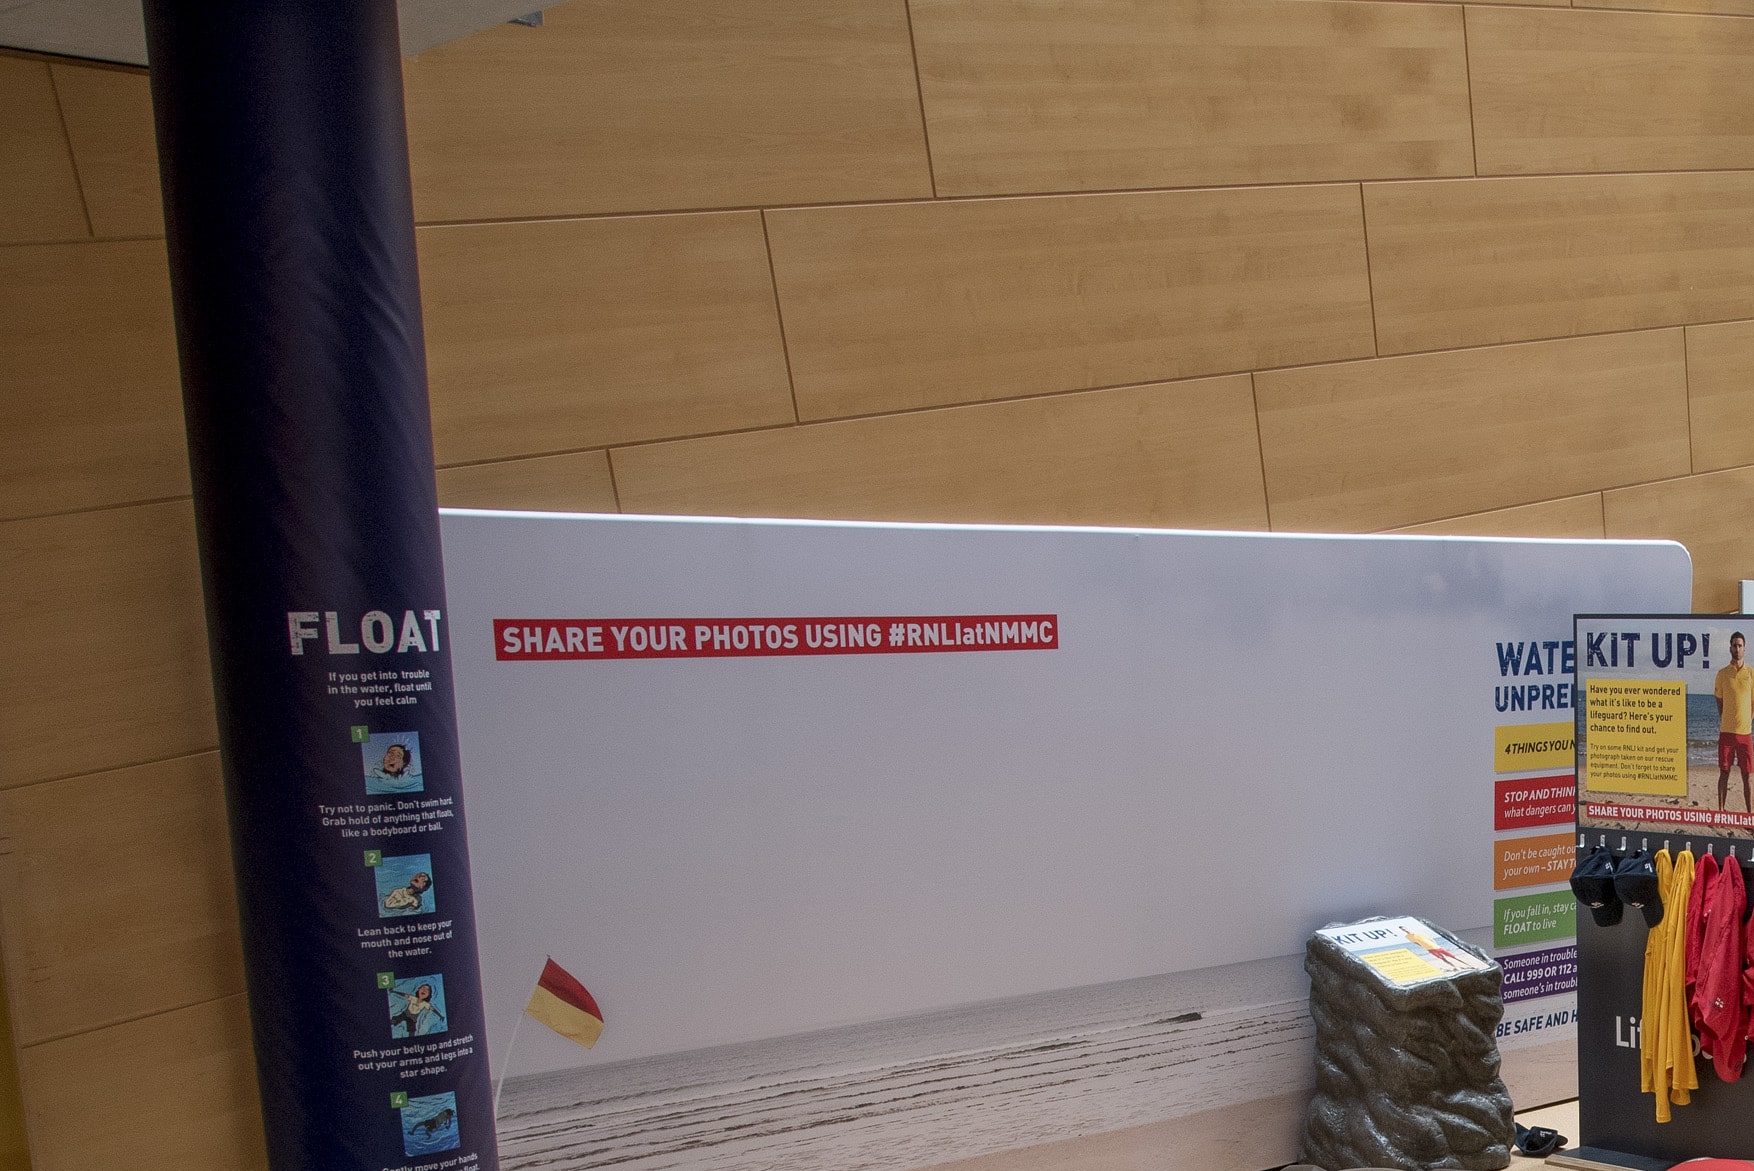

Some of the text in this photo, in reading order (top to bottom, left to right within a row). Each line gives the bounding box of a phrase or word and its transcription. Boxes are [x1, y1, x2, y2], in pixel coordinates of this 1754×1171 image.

[287, 610, 440, 655] FLOAT
[503, 620, 1053, 653] SHARE YOUR PHOTOS USING #RNLIatNMMC
[1587, 632, 1710, 668] KIT UP!
[1496, 641, 1574, 676] WATE
[329, 670, 429, 683] If you get into trouble
[328, 682, 432, 694] in the water, float until
[1590, 685, 1607, 693] Have
[1610, 687, 1622, 695] you
[1643, 687, 1680, 695] wondered
[355, 696, 416, 708] you feel calm
[1495, 683, 1574, 712] UNPRE
[1609, 699, 1620, 707] it's
[1622, 699, 1636, 707] like
[1590, 711, 1672, 722] lifeguard? Here's your
[356, 729, 362, 739] 1
[1590, 724, 1615, 732] chance
[1626, 725, 1640, 733] find
[1505, 739, 1569, 754] 4 THINGS YOU
[1504, 789, 1528, 803] STOP
[1530, 787, 1549, 800] AND
[319, 805, 335, 814] Try
[338, 805, 353, 813] not
[355, 804, 365, 812] to
[368, 803, 395, 813] panic.
[398, 800, 419, 809] Don't
[421, 799, 438, 808] swim
[1504, 804, 1569, 818] what dangers can
[1589, 805, 1618, 816] SHARE
[1620, 807, 1643, 819] YOUR
[1646, 809, 1681, 820] PHOTOS
[1684, 811, 1712, 822] USING
[322, 817, 345, 825] Grab
[349, 816, 369, 824] hold
[372, 815, 381, 823] of
[384, 813, 420, 824] anything
[422, 811, 435, 819] that
[341, 829, 359, 837] like
[370, 825, 416, 836] bodyboard
[369, 854, 376, 863] 2
[1504, 846, 1576, 862] Don't be caught ou
[1503, 861, 1568, 880] your own STAY
[1504, 904, 1569, 920] If you fall in, stay
[1504, 920, 1556, 935] FLOAT to live
[1332, 929, 1397, 944] KIT UP!
[1504, 955, 1539, 970] Someone
[1541, 954, 1548, 963] in
[382, 976, 389, 985] 3
[1504, 965, 1571, 985] CALL 999 OR 112
[1503, 978, 1577, 999] someone's in troubl
[1496, 1011, 1566, 1037] BE SAFE AND
[396, 1095, 402, 1104] 4
